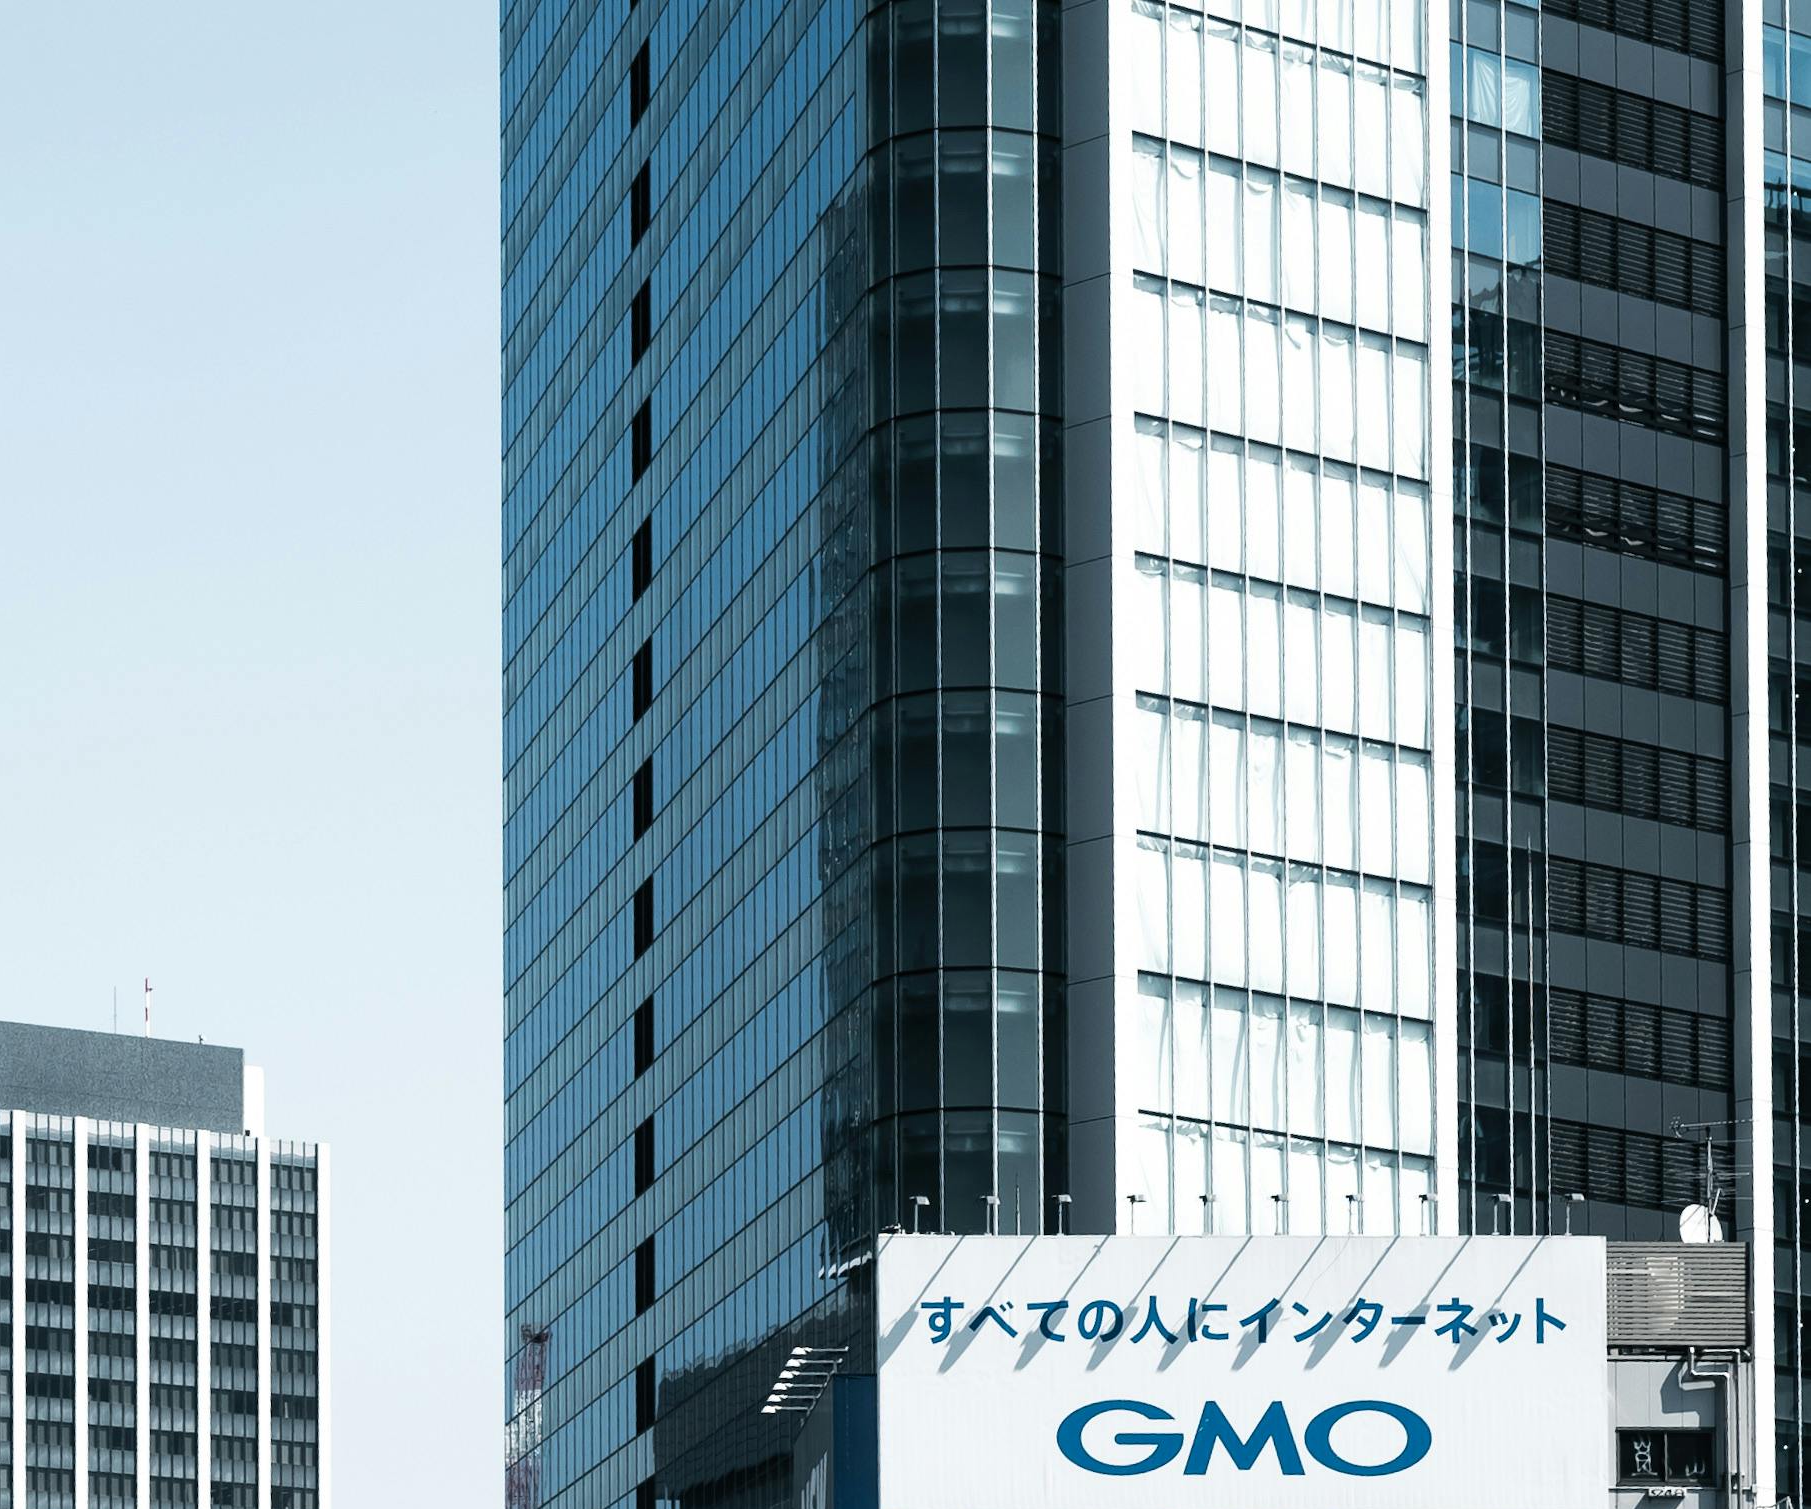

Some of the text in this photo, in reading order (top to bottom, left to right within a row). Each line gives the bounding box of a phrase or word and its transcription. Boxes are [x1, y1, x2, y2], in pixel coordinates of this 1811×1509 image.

[920, 1297, 1567, 1345] すべての人にインターネット
[1056, 1399, 1433, 1477] GMO
